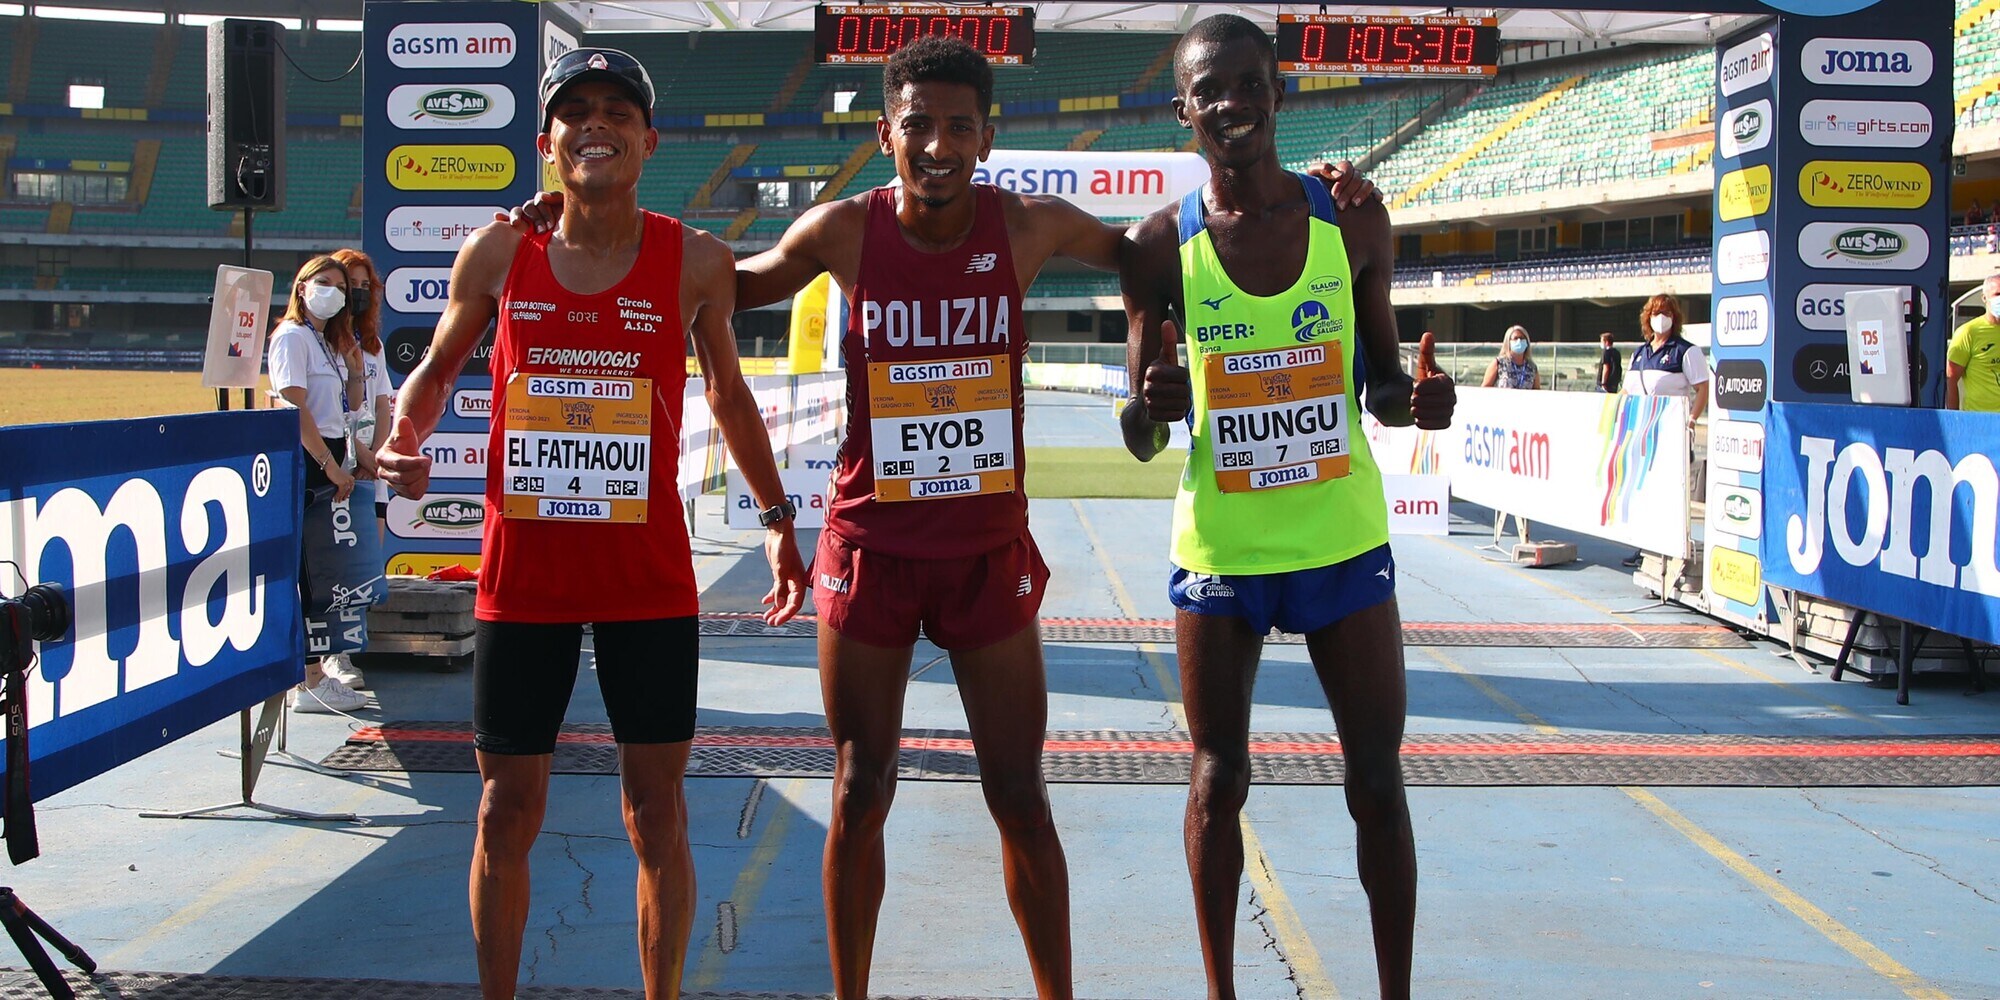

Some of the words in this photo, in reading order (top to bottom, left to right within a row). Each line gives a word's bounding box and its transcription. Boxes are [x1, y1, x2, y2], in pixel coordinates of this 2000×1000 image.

[830, 6, 846, 14] TDS
[851, 6, 884, 15] tds.sport
[908, 7, 941, 15] tds.sport
[945, 7, 961, 15] TDS
[965, 7, 998, 16] tds.sport
[1002, 8, 1019, 16] TDS
[1294, 15, 1310, 23] TDS
[1314, 14, 1348, 24] tds.sport
[1351, 15, 1367, 23] TDS
[1371, 16, 1404, 24] tds.sport
[1428, 17, 1461, 26] tds.sport
[1466, 18, 1482, 26] TDS
[466, 37, 512, 54] aim
[829, 55, 846, 63] TDS
[850, 54, 883, 64] tds.sport
[1002, 56, 1019, 64] TDS
[1293, 63, 1310, 71] TDS
[1314, 63, 1348, 72] tds.sport
[1351, 64, 1367, 72] TDS
[1371, 64, 1404, 73] tds.sport
[1409, 64, 1425, 73] TDS
[1428, 65, 1461, 74] tds.sport
[1466, 66, 1482, 74] TDS
[1090, 168, 1164, 195] aim
[617, 297, 652, 309] Circolo
[1801, 298, 1845, 316] ags
[568, 311, 598, 323] GORE
[620, 310, 663, 323] Minerva
[862, 296, 1010, 349] POLIZIA
[1199, 345, 1221, 354] Banca
[1287, 348, 1322, 365] aim
[541, 348, 641, 369] FORNOVOGAS
[952, 361, 989, 377] aim
[592, 382, 630, 397] aim
[1217, 402, 1338, 444] RIUNGU
[901, 418, 984, 452] EYOB
[509, 437, 532, 467] EL
[537, 438, 645, 472] FATHAOUI
[1276, 445, 1288, 462] 7
[1509, 429, 1550, 480] aim
[938, 456, 951, 473] 2
[567, 476, 582, 494] 4
[1394, 499, 1438, 515] aim
